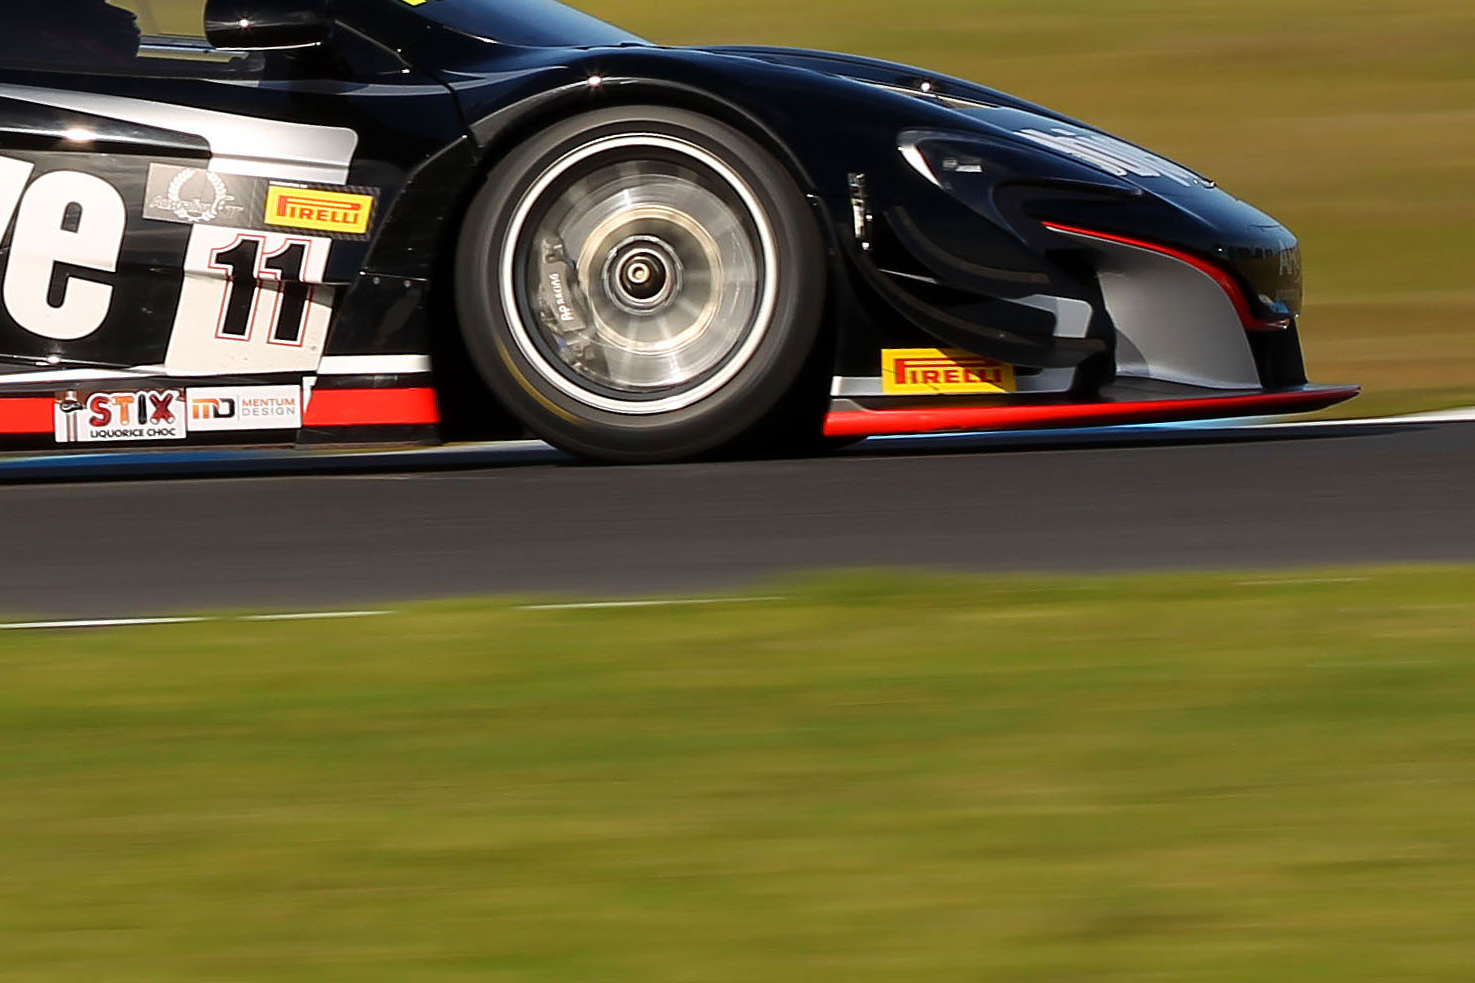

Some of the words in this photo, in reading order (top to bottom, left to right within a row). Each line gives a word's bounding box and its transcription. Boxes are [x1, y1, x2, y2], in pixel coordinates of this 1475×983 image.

[276, 195, 362, 224] PIRELLI
[208, 234, 311, 347] 11
[894, 357, 1004, 385] PIRELLI
[89, 393, 175, 426] STIX
[241, 397, 296, 407] MENTUM
[241, 406, 296, 416] DESIGN
[90, 429, 144, 439] LIQUORICE
[146, 427, 177, 437] CHOC
